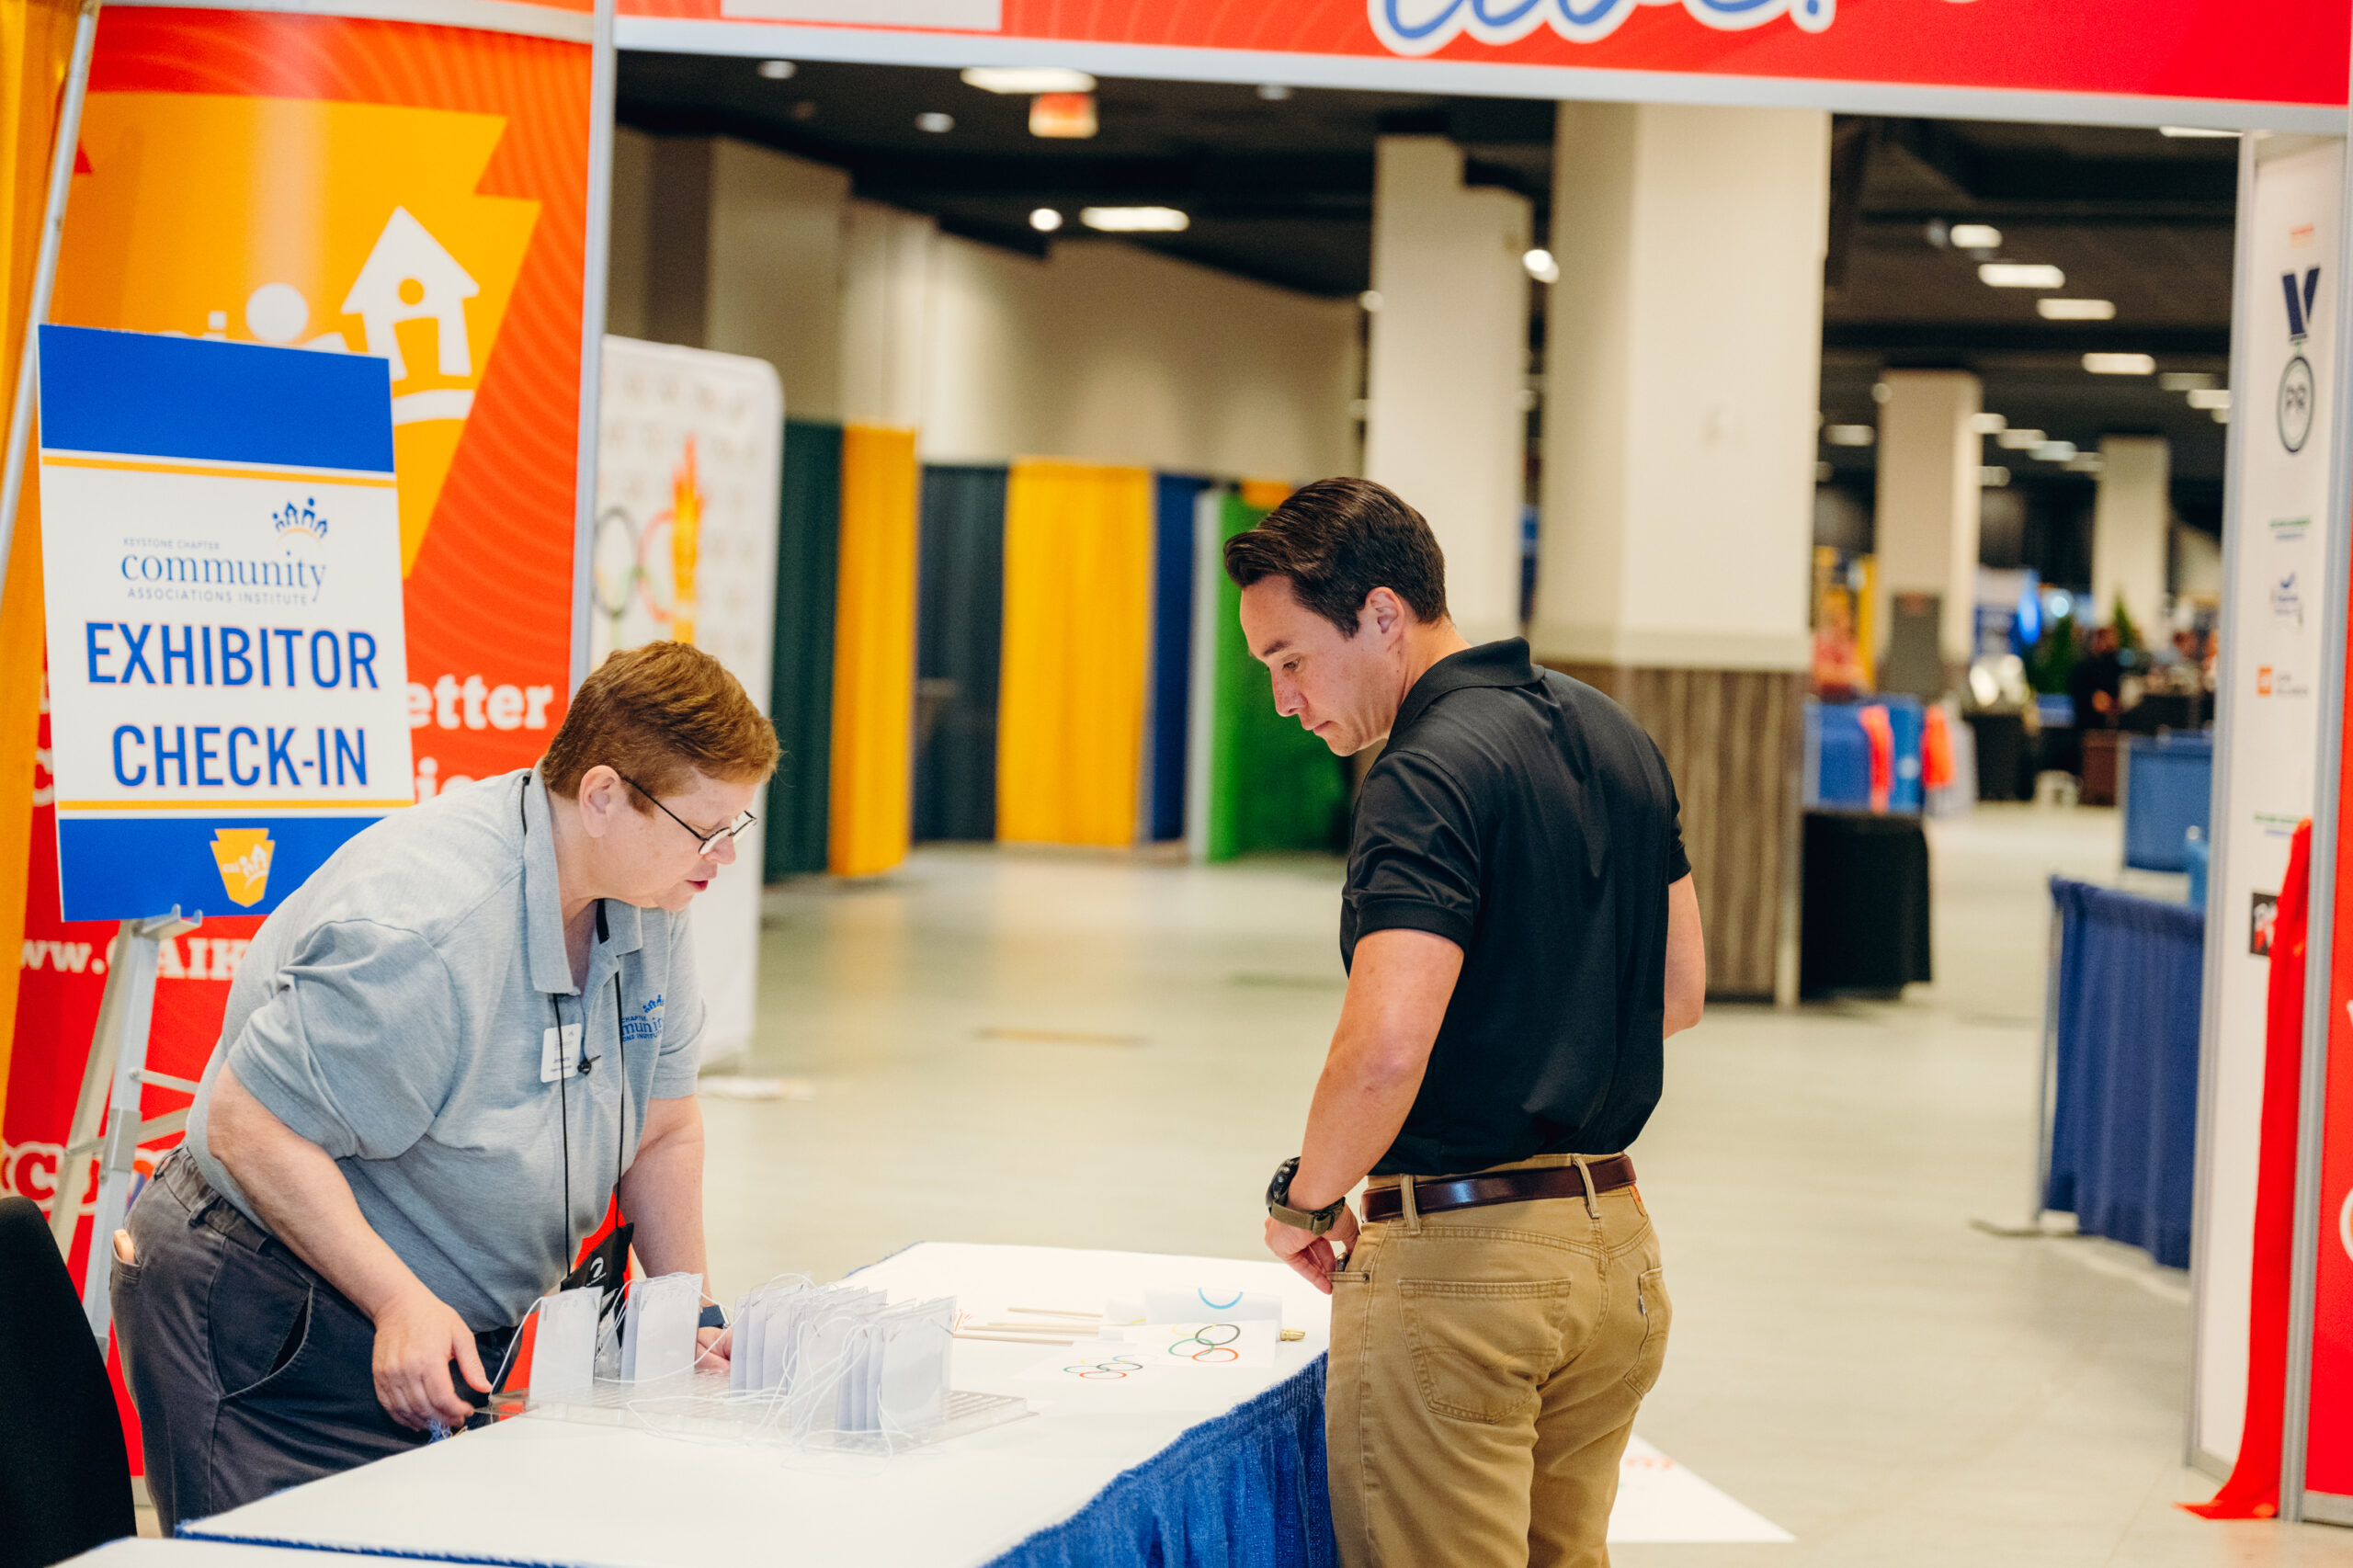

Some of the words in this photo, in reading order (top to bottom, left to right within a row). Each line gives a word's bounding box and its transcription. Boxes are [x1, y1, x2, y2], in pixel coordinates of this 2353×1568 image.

[123, 537, 173, 548] KEYSTONE
[176, 539, 220, 550] CHAPTER
[121, 551, 326, 603] community
[127, 587, 233, 603] ASSOCIATIONS
[238, 592, 308, 607] INSTITUTE
[85, 621, 379, 689] EXHIBITOR
[112, 724, 368, 787] CHECK-IN
